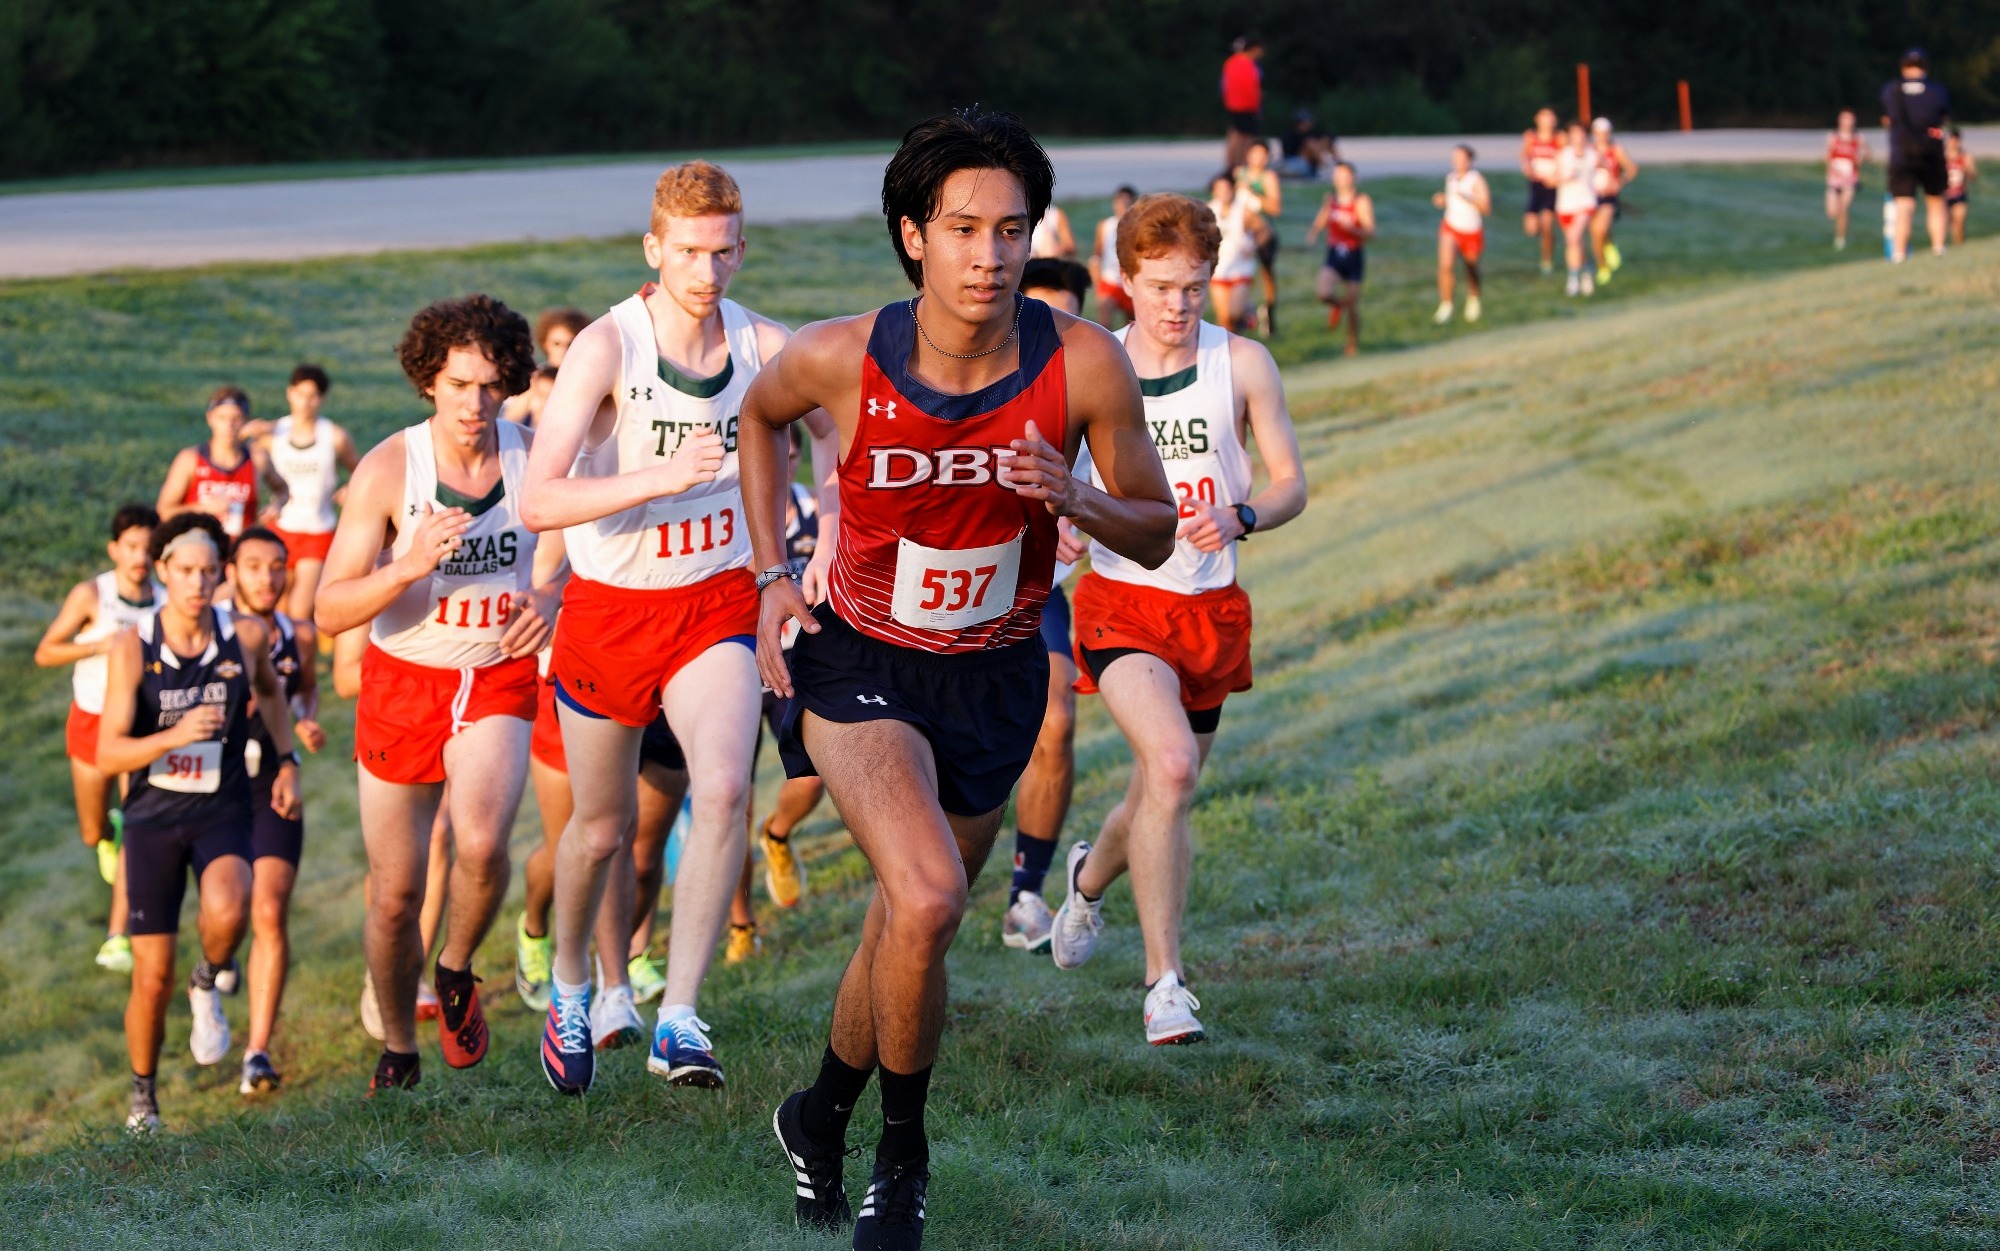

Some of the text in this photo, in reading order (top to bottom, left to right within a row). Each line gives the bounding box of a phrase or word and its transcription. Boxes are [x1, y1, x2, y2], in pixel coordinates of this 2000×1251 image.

[651, 416, 739, 457] TEAS
[1151, 418, 1209, 454] XAS
[1162, 447, 1189, 460] LAS
[1174, 477, 1216, 519] 20
[440, 531, 517, 566] EXAS
[656, 508, 735, 557] 1113
[444, 561, 499, 576] DALLAS
[919, 564, 998, 611] 537
[435, 592, 512, 628] 1119
[166, 754, 204, 780] 591
